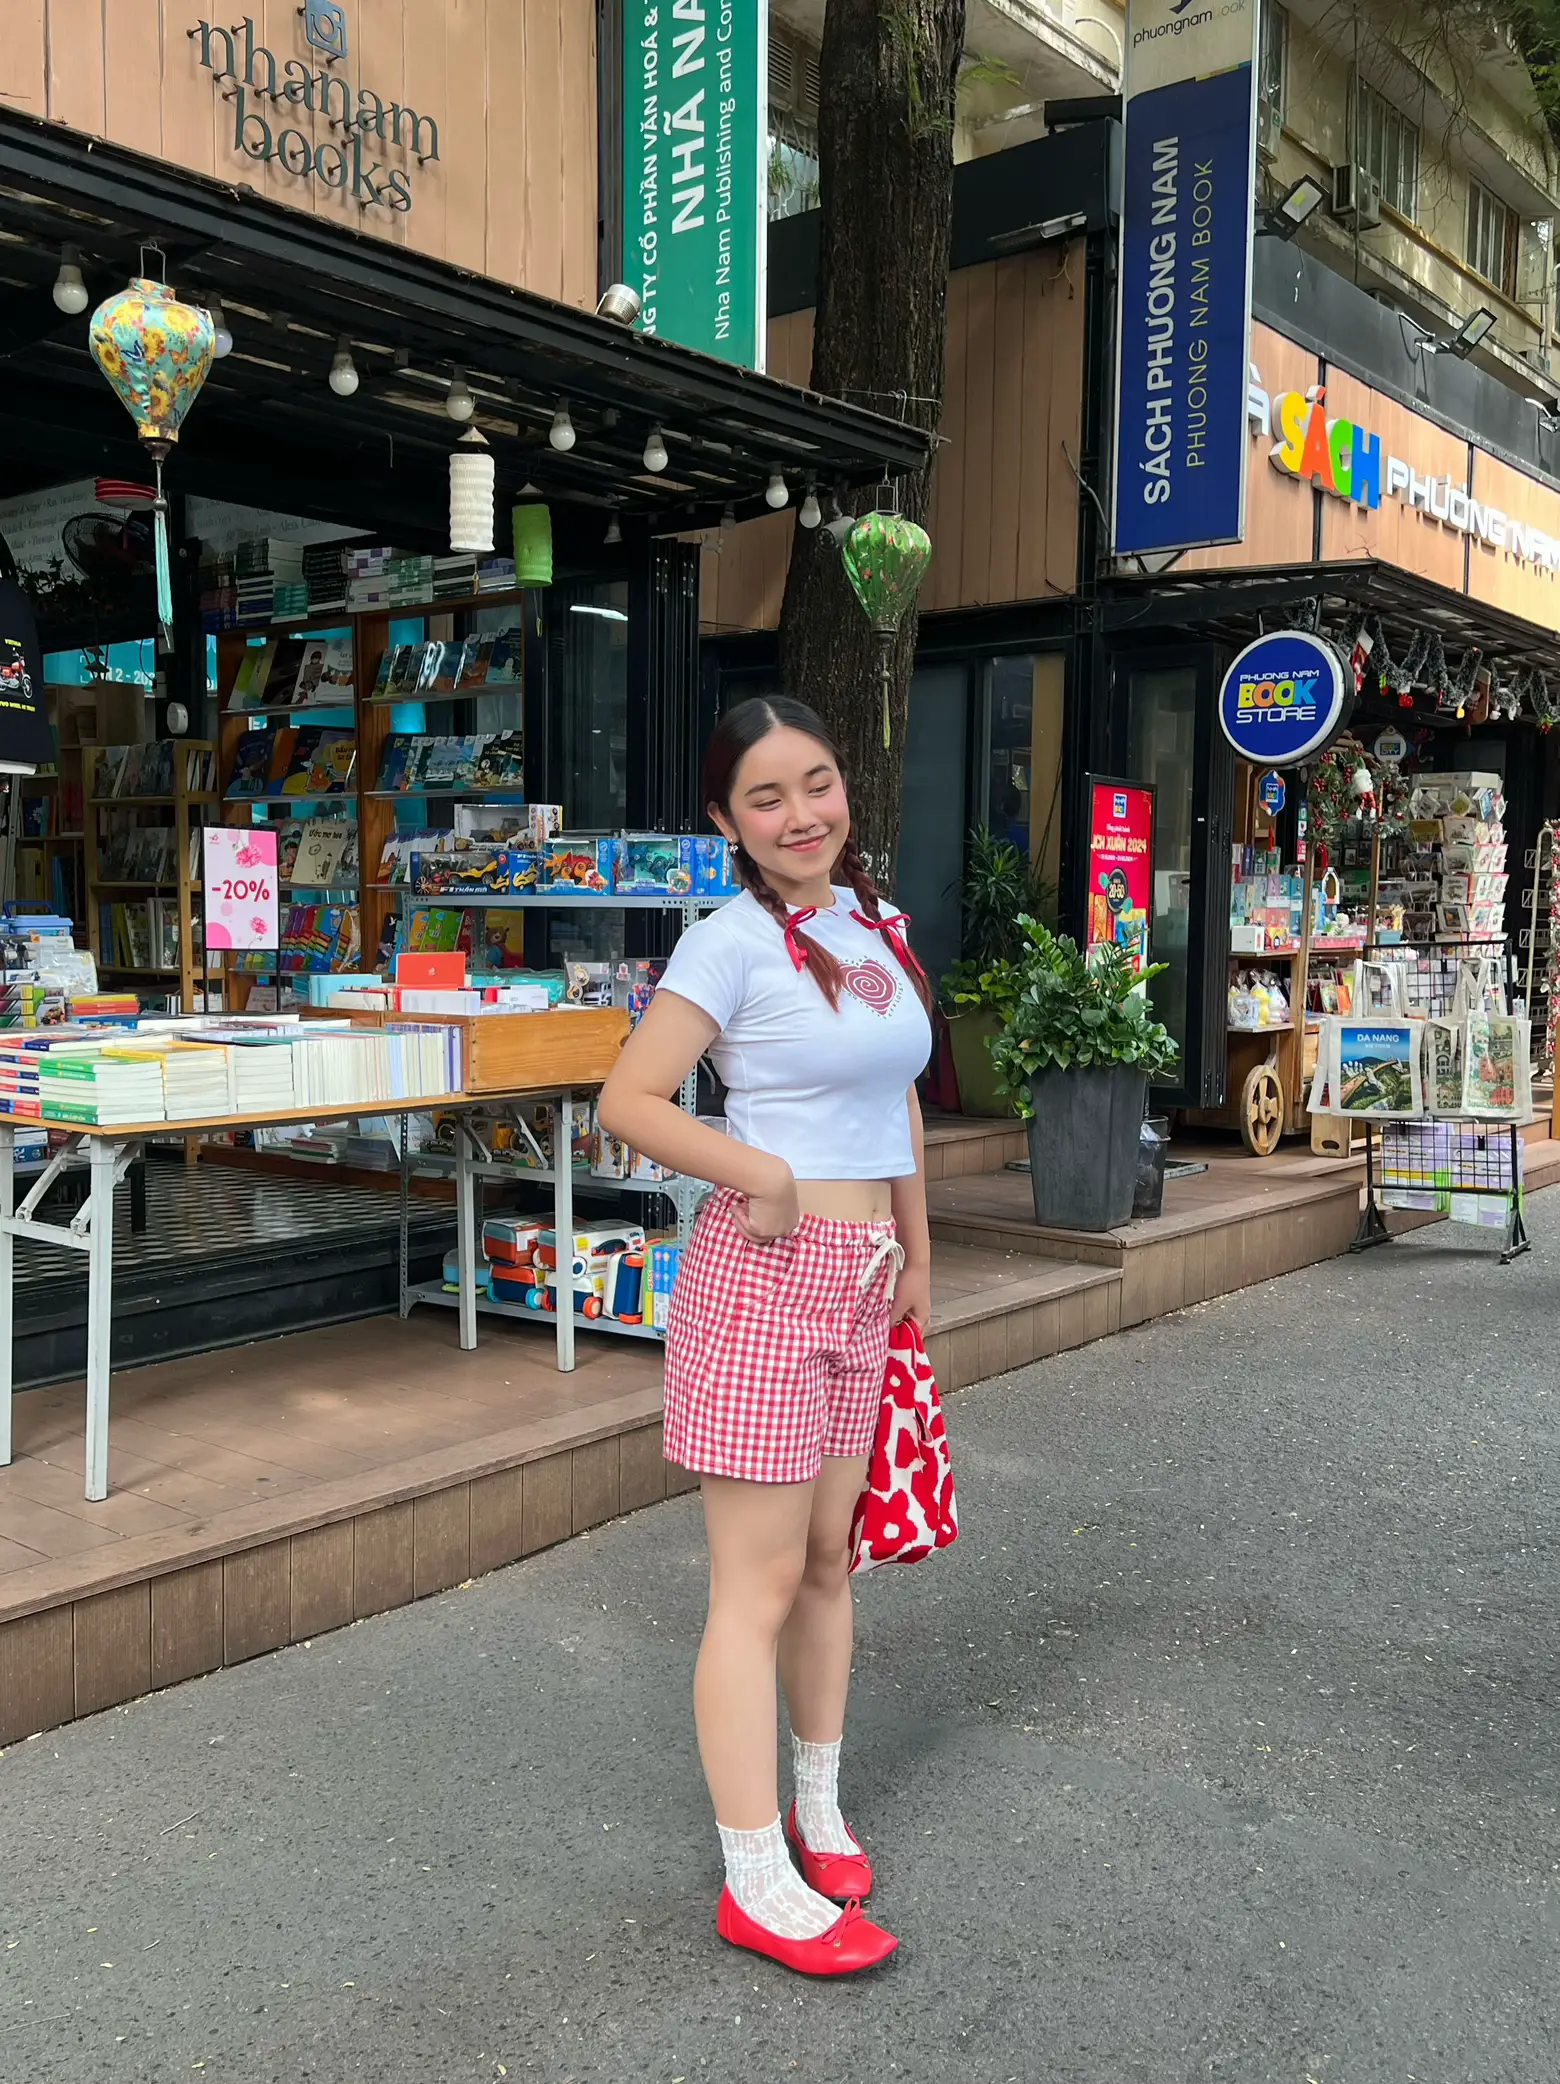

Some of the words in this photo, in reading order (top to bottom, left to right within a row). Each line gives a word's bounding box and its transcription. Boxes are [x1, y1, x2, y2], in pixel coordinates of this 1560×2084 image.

[644, 6, 658, 27] &
[197, 17, 440, 161] nhanam
[641, 31, 658, 90] HOÁ
[716, 48, 731, 92] and
[234, 84, 411, 212] books
[640, 95, 657, 150] VĂN
[663, 88, 705, 234] NHÃ
[716, 98, 735, 222] Publishing
[1151, 136, 1179, 225] NAM
[639, 155, 657, 225] PHẦN
[1192, 159, 1213, 246] BOOK
[638, 231, 657, 265] CỔ
[716, 229, 731, 286] Nam
[643, 273, 657, 303] TY
[715, 292, 730, 339] Nha
[1145, 232, 1177, 391] PHƯƠNG
[1190, 258, 1210, 327] NAM
[1186, 339, 1208, 467] PHUONG
[1139, 398, 1172, 504] SÁCH
[1269, 385, 1380, 510] SÁCH
[1238, 678, 1318, 708] BOOK
[1240, 671, 1289, 682] PHUONG
[1292, 669, 1320, 678] NAM
[1236, 706, 1317, 723] STORE
[211, 879, 270, 902] -20%
[1357, 1033, 1371, 1042] DA
[1372, 1033, 1400, 1043] NANG
